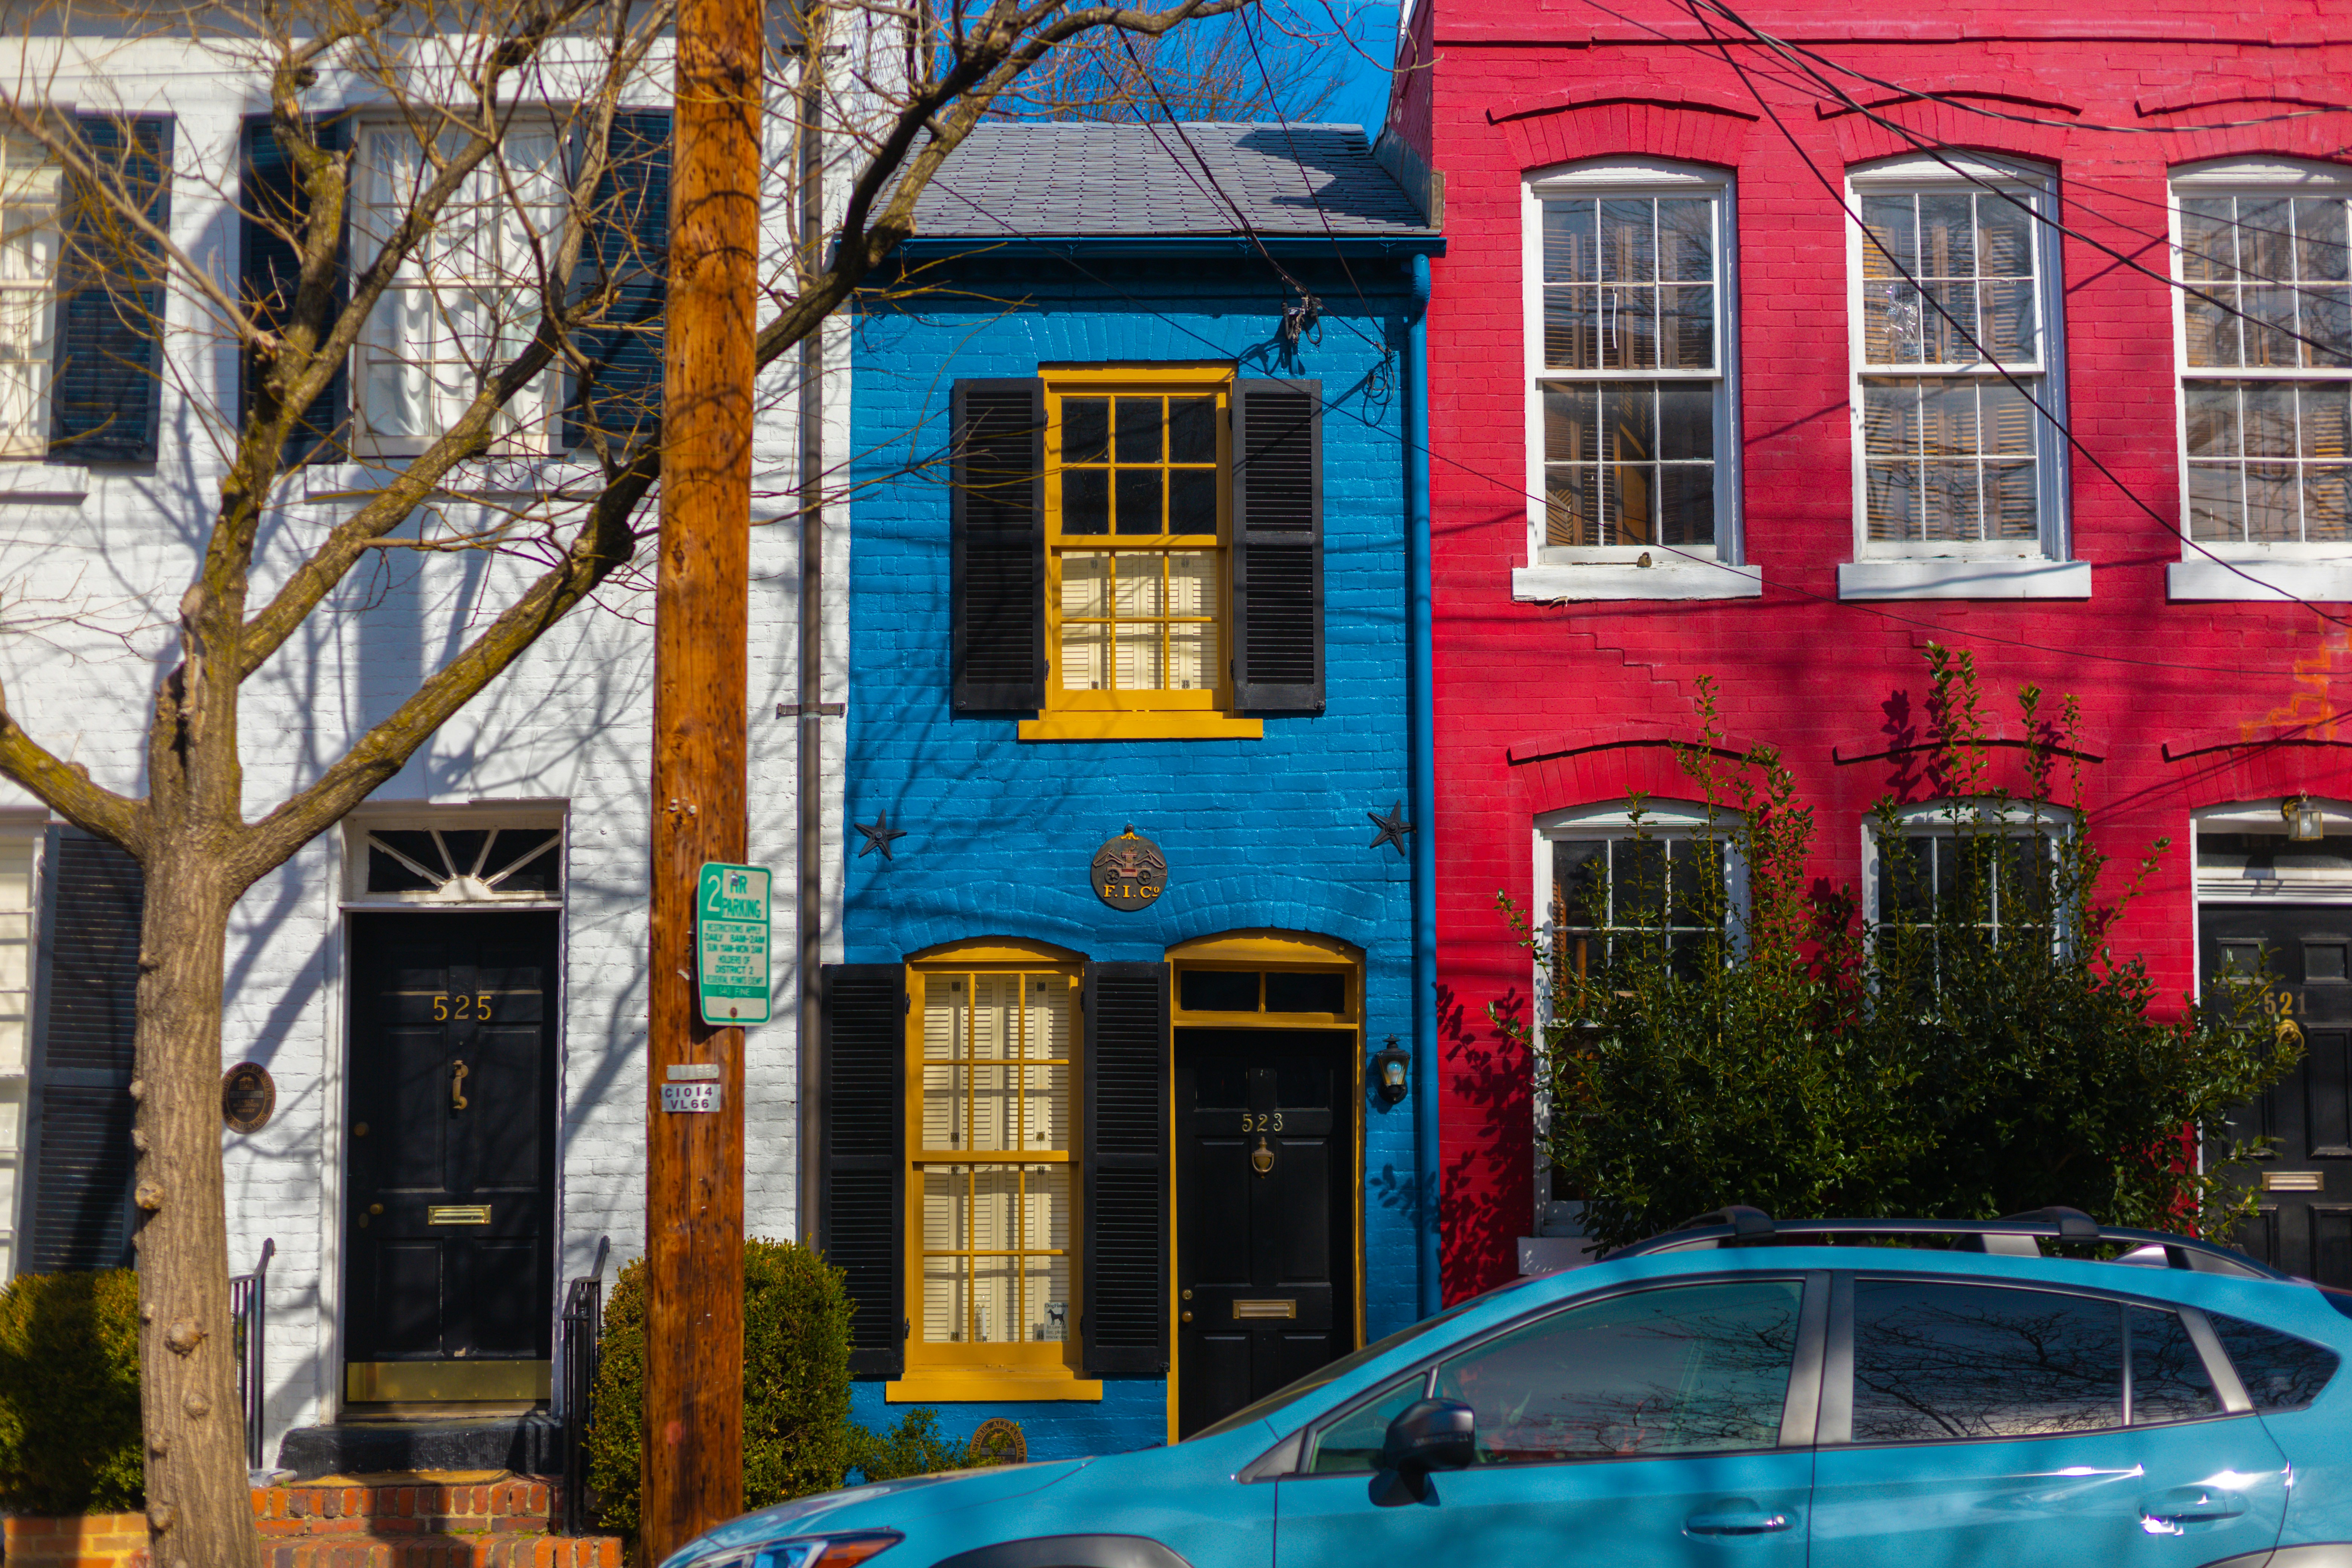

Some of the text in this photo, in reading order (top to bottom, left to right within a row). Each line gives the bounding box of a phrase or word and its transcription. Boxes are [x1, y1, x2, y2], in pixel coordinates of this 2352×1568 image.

[707, 875, 721, 912] 2
[722, 898, 761, 918] PARKING
[704, 933, 723, 942] DAILY
[707, 923, 761, 934] RESTRICTIONS APPLY
[706, 943, 717, 951] SUN
[751, 945, 763, 954] 2AM
[718, 955, 741, 964] HOLDERS
[715, 965, 753, 975] DISTRICT 2
[735, 988, 751, 996] FINE
[434, 995, 492, 1021] 525
[2264, 992, 2307, 1015] 521
[242, 1064, 271, 1100] ALEXANDRIA
[670, 1099, 709, 1110] VL66
[225, 1112, 267, 1130] FOUNDATION
[1242, 1113, 1283, 1132] 523
[972, 1421, 1024, 1458] ISTORIC ALEXANDRIA
